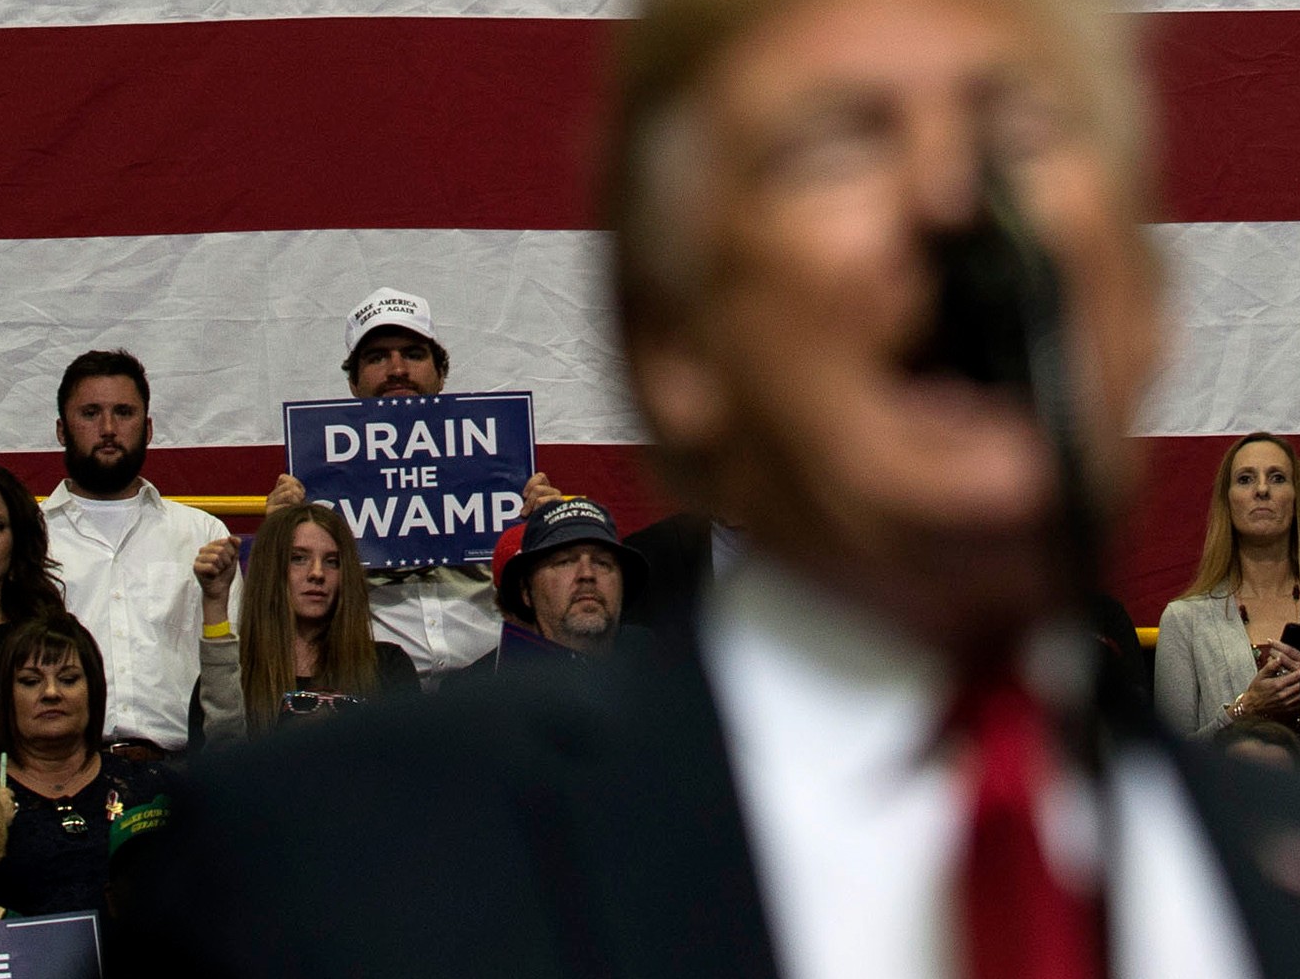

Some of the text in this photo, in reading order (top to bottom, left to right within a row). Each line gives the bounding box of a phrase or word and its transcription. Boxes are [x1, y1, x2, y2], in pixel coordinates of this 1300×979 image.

[355, 299, 418, 320] MAKE AMERICA
[360, 306, 415, 326] GREAT AGAIN
[324, 417, 498, 463] DRAIN
[380, 465, 439, 490] THE
[311, 490, 524, 539] WAMP
